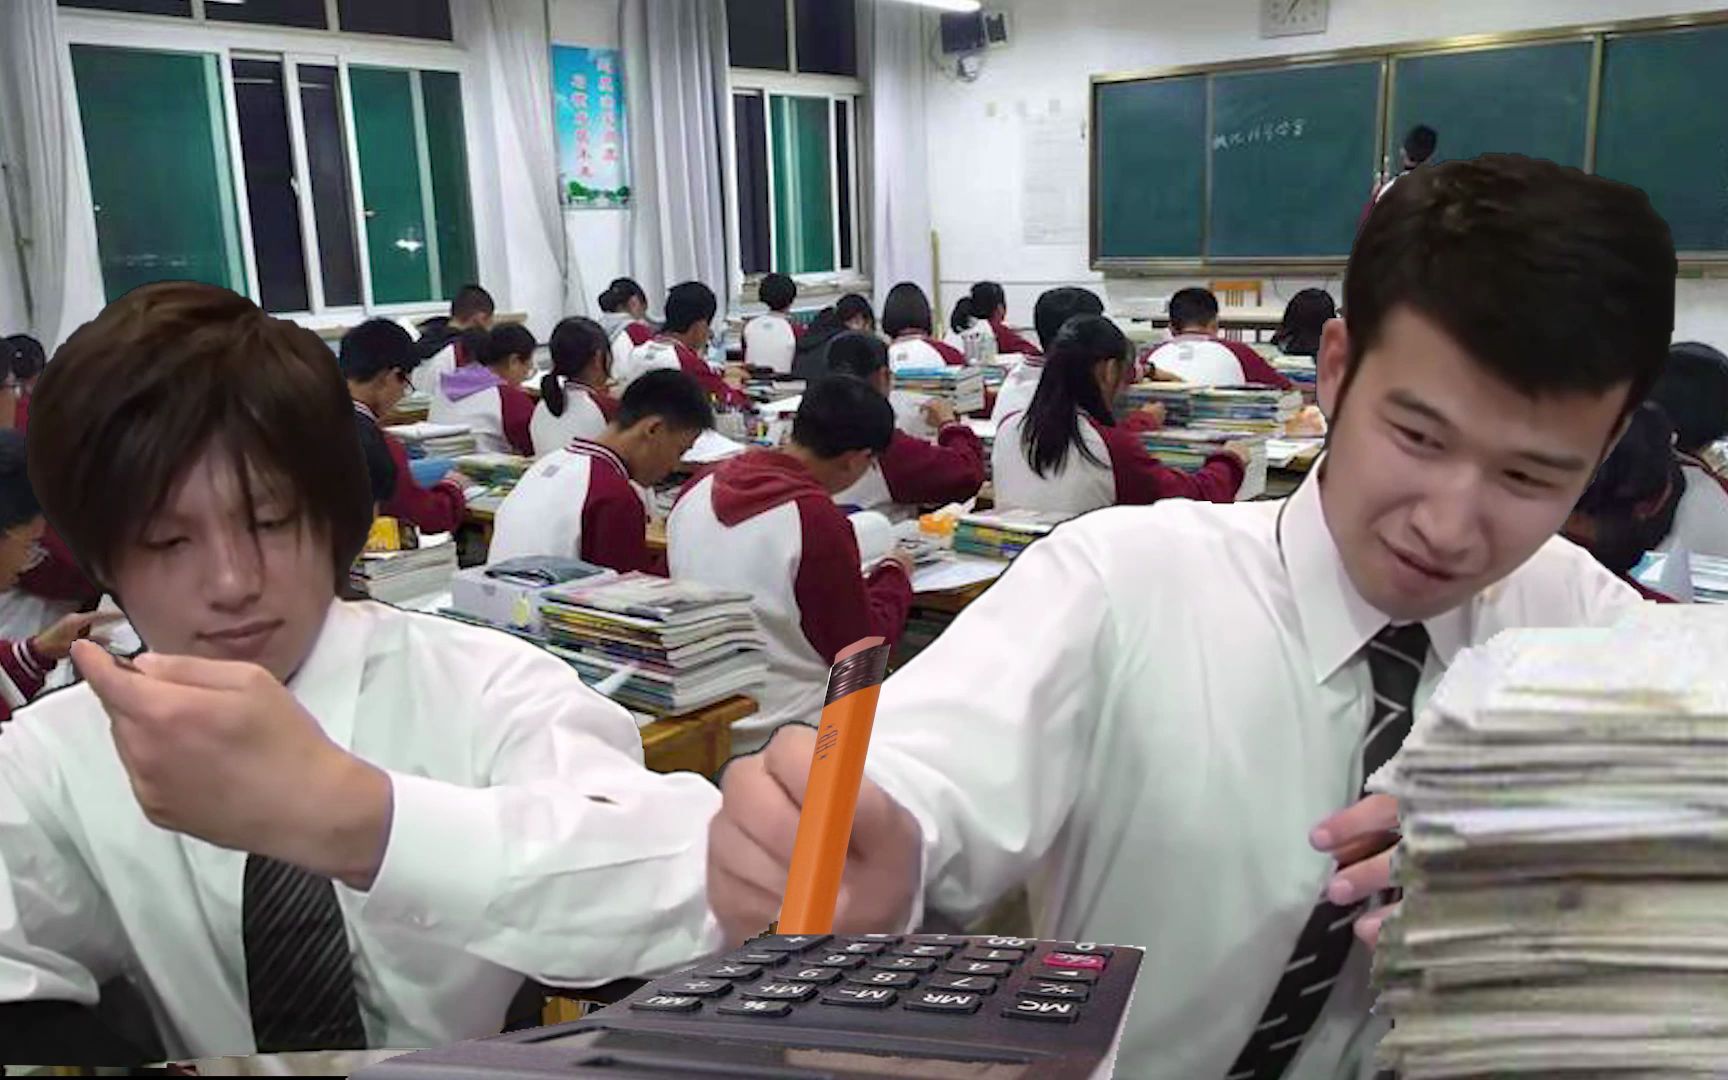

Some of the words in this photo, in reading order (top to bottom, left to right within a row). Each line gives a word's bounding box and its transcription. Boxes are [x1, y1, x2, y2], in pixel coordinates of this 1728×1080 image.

[988, 938, 1026, 947] 00
[823, 954, 847, 965] 6
[967, 962, 991, 972] 4
[798, 968, 823, 978] 9
[872, 972, 897, 983] 8
[951, 976, 974, 987] 7
[760, 984, 809, 994] M+
[922, 993, 972, 1005] MR
[1017, 1000, 1071, 1014] MC
